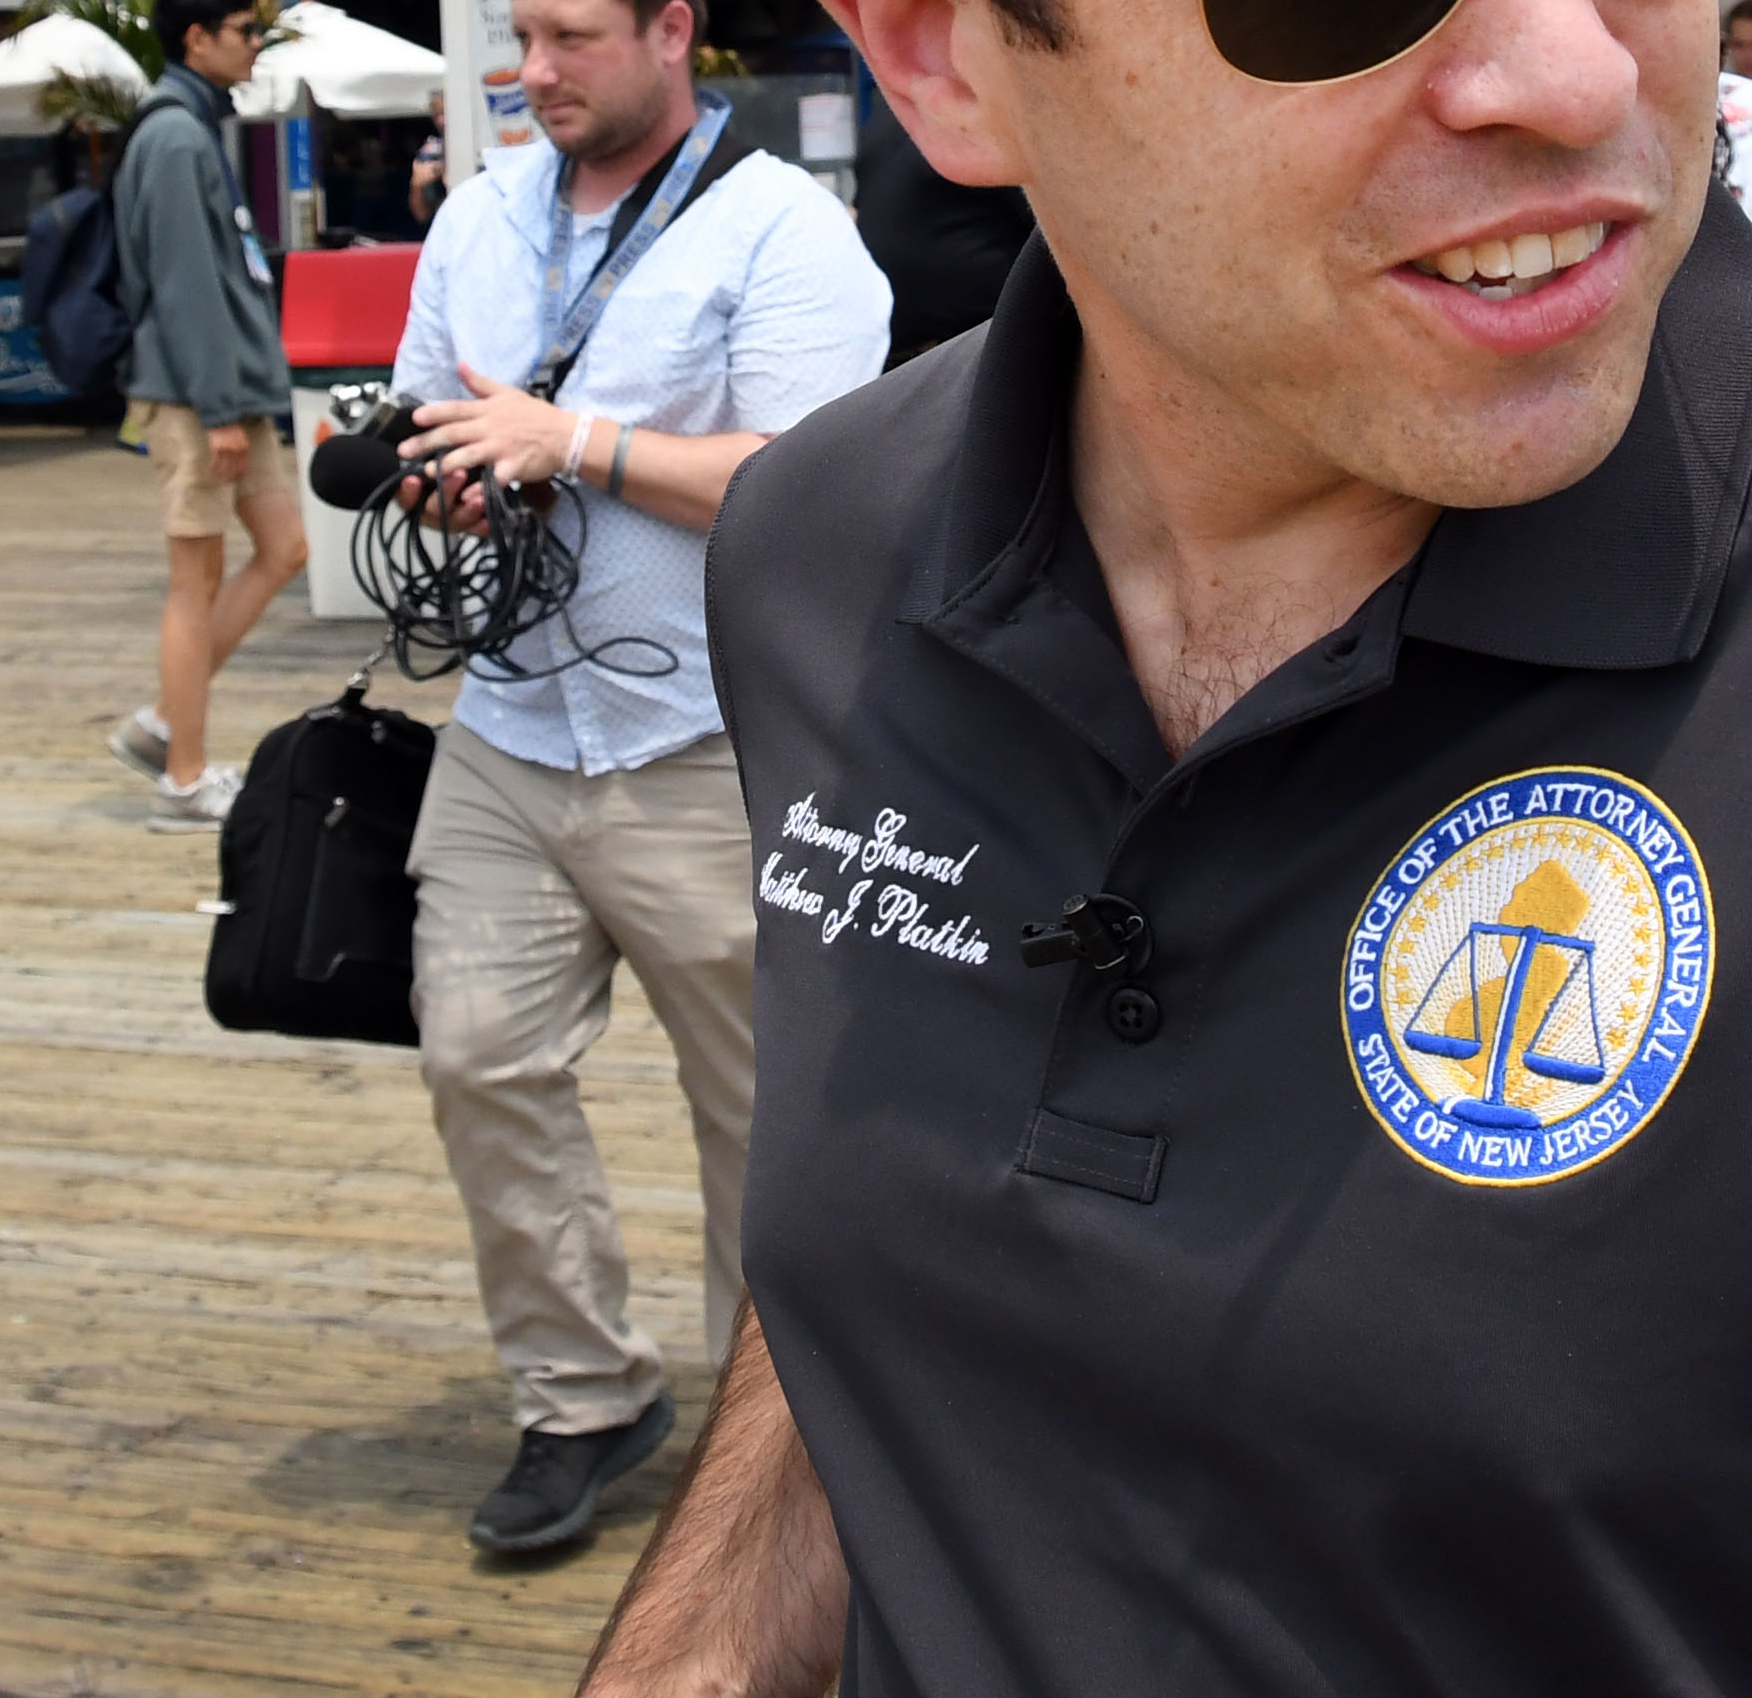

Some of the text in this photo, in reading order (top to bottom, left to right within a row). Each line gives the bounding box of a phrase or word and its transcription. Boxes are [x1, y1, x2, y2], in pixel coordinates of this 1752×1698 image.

[860, 807, 980, 886] General
[870, 883, 990, 966] Platkin
[1348, 782, 1703, 1065] OFFICE OF THE ATTORNEY GENERAL
[1358, 1032, 1646, 1168] STATE OF NEW JERSEY
